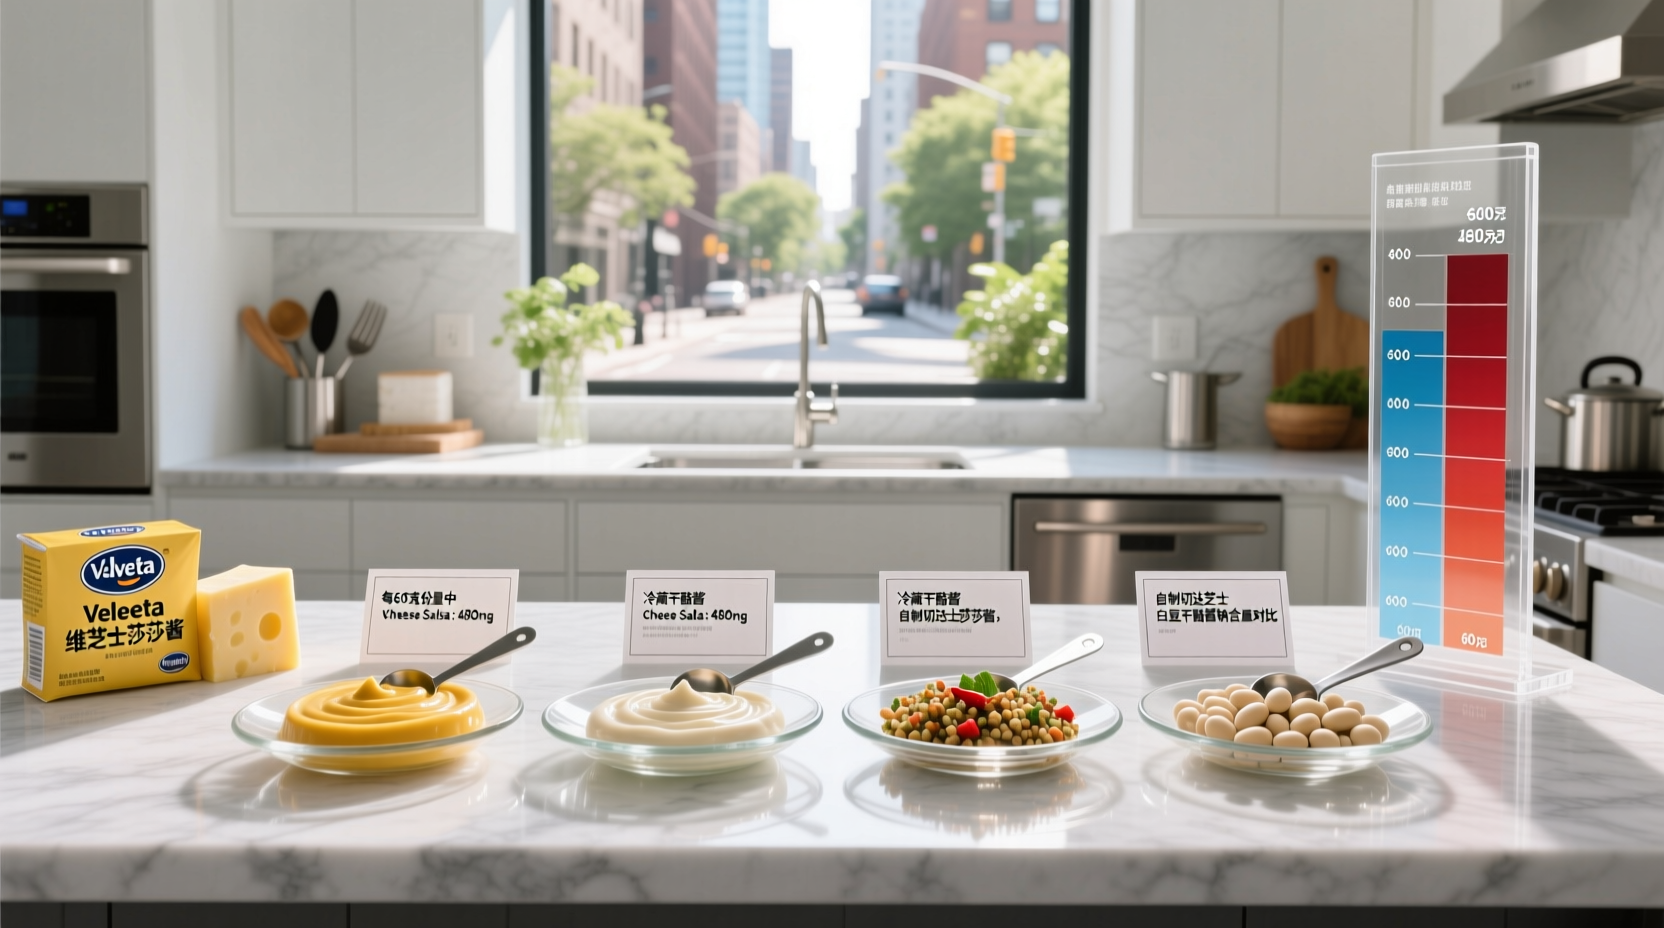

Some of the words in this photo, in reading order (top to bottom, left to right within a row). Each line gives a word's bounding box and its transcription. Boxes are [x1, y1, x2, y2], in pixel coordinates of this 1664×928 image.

[1388, 296, 1411, 308] 600
[1386, 495, 1409, 508] 600
[83, 600, 164, 623] Veleeta
[65, 618, 185, 653] 维芝士莎莎酱
